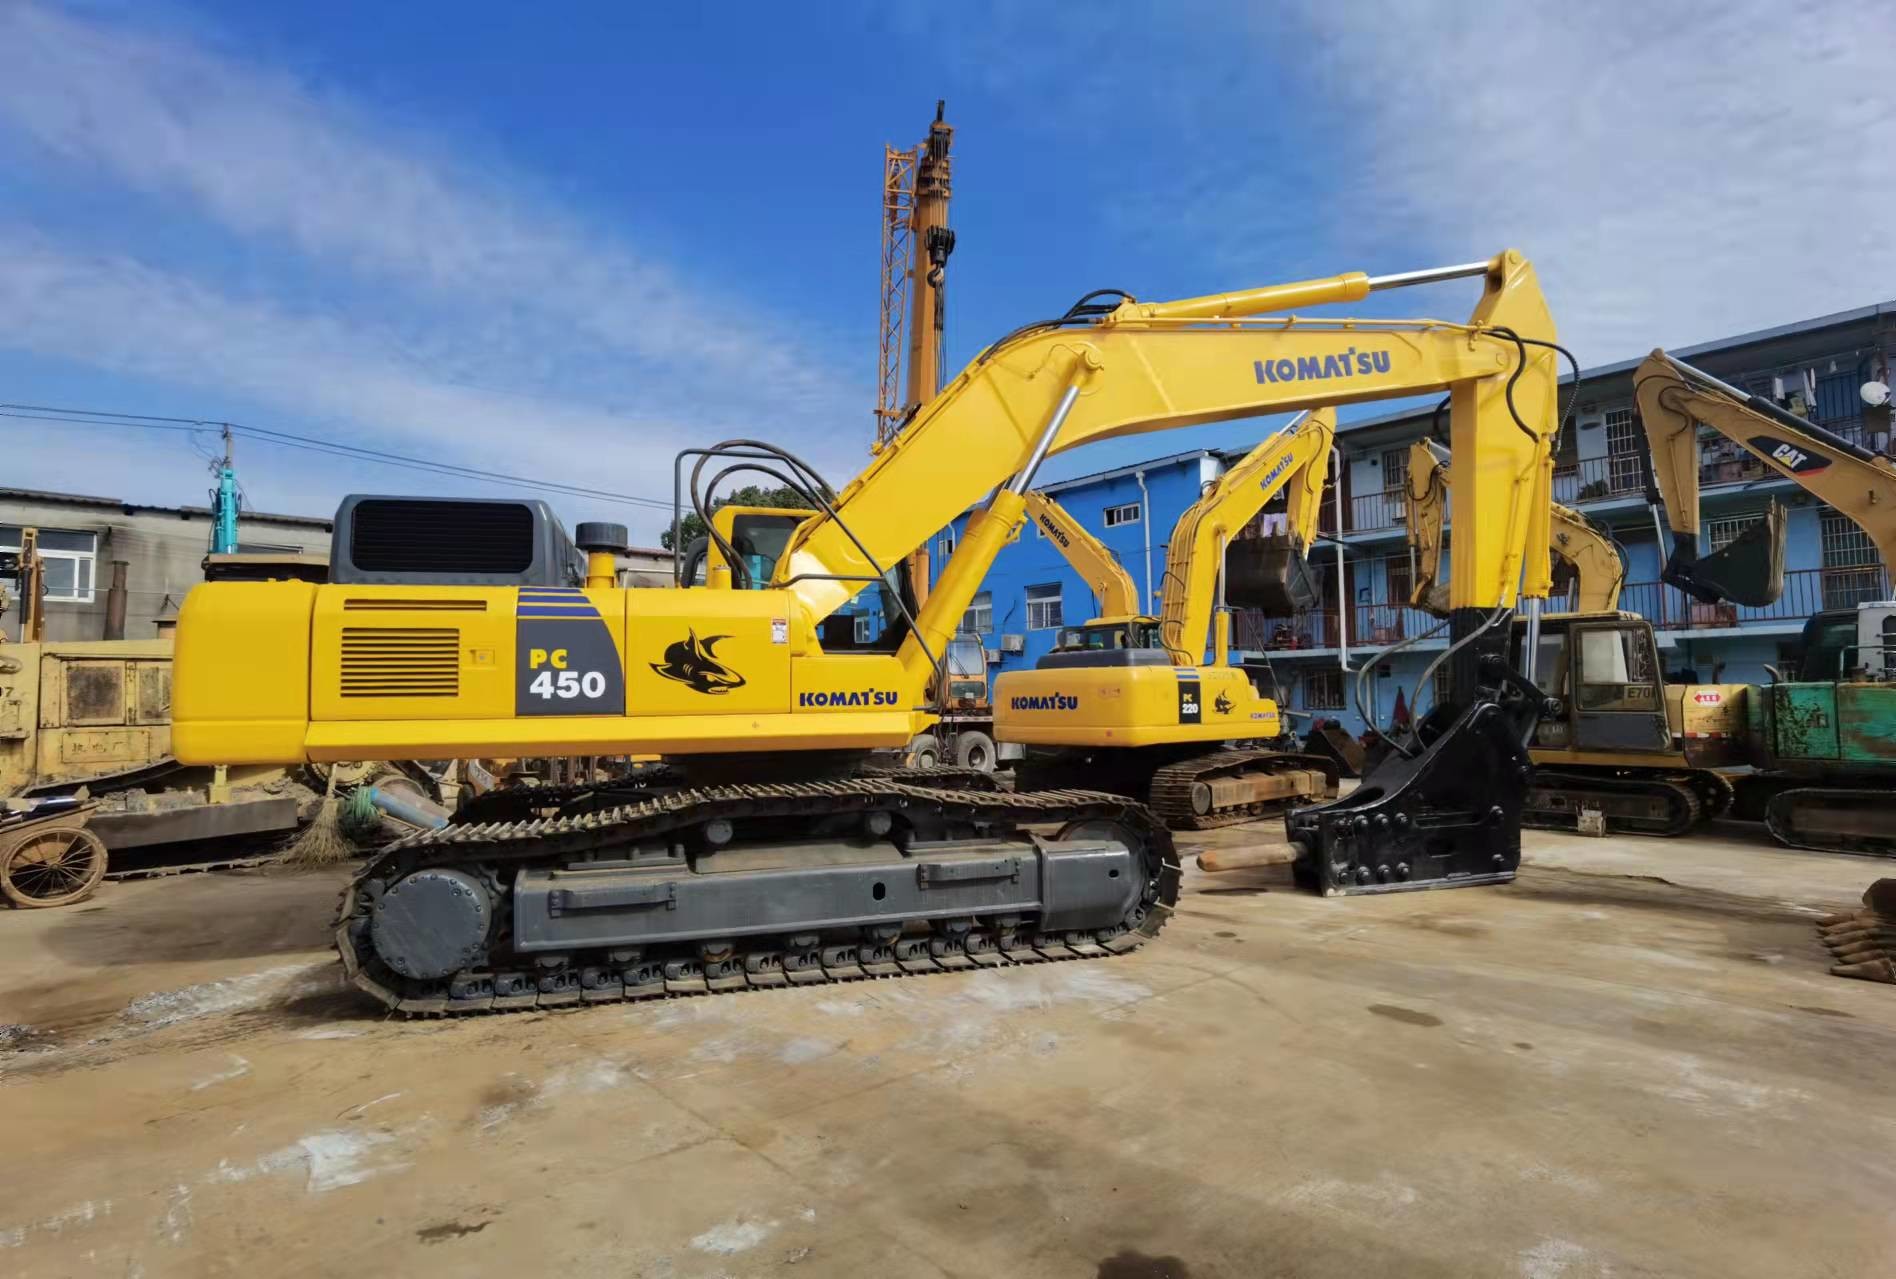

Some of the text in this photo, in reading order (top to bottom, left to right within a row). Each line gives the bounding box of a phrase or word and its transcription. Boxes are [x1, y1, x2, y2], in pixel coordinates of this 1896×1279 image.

[1253, 346, 1391, 385] KOMATSU
[1772, 444, 1807, 469] CAT
[1260, 452, 1294, 490] KOMATSU
[1040, 513, 1070, 548] KOMATSU
[529, 648, 568, 669] PC
[529, 671, 606, 699] 450
[799, 687, 898, 707] KOMATSU
[1011, 691, 1078, 710] KOMATSU
[1181, 703, 1199, 714] 220
